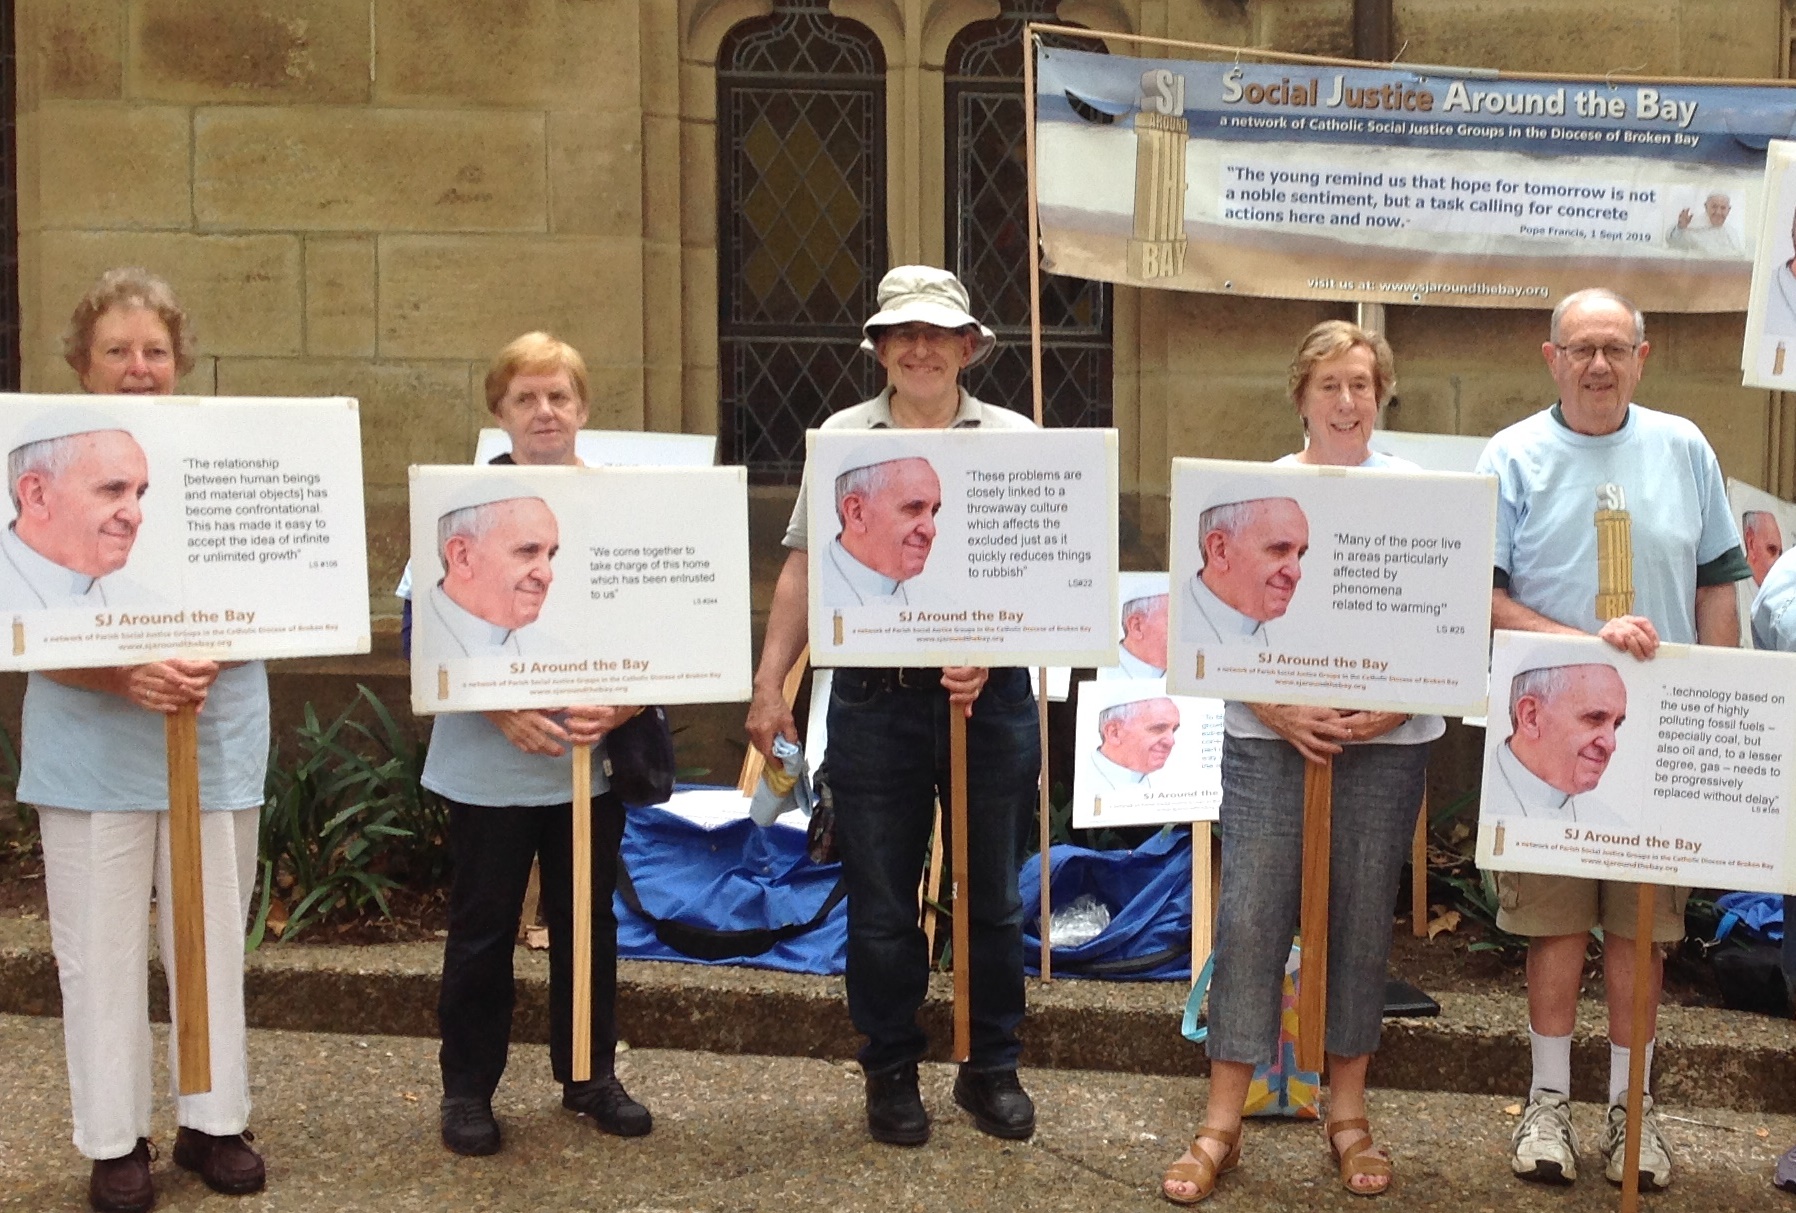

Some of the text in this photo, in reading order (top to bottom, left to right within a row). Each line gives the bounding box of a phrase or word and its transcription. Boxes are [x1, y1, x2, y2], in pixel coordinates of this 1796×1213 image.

[1155, 69, 1185, 116] SJ
[1222, 70, 1698, 127] Social Justice Around the Bay
[1149, 115, 1188, 132] AROUND
[1220, 115, 1700, 147] a network of Catholic Social Justice Groups in the Diocese of Broken Bay
[1228, 166, 1655, 203] "The young remind us that hope for tomorrow is not
[1226, 188, 1628, 221] a noble sentiment, but a task calling for concrete
[1225, 206, 1283, 222] actions
[1289, 209, 1325, 224] here
[1330, 212, 1360, 225] and
[1520, 225, 1545, 237] Pope
[1548, 227, 1586, 240] Francis,
[1592, 230, 1595, 238] 1
[1600, 230, 1622, 241] Sept
[1142, 241, 1188, 279] BAY
[1308, 277, 1549, 298] visit us at: www.sjaroundthebay.org
[213, 458, 279, 469] relationship
[240, 474, 320, 486] human beings
[1009, 470, 1081, 483] problems are
[185, 489, 327, 500] and material has
[967, 486, 1040, 500] closely linked
[186, 506, 232, 515] become
[967, 503, 1068, 515] throwaway culture
[187, 520, 311, 531] This has made easy
[968, 518, 1060, 530] which affects the
[188, 534, 329, 548] accept the idea infinite
[968, 534, 1041, 548] excluded just
[1390, 536, 1461, 549] the poor live
[203, 551, 255, 562] unlimited
[613, 546, 683, 558] come together
[968, 550, 1091, 564] quickly reduces things
[590, 560, 710, 572] take charge this home
[1348, 552, 1448, 567] areas particularly
[591, 573, 715, 585] which has been entrusted
[1334, 566, 1379, 579] affected
[1333, 583, 1402, 596] phenomena
[1333, 599, 1372, 611] related
[95, 610, 255, 627] SJ Around the Bay
[899, 610, 1023, 623] SJ Around the Bay
[510, 659, 649, 674] SJ Around the Bay
[1259, 653, 1388, 672] SJ Around the Bay
[1735, 691, 1767, 702] based
[1661, 700, 1749, 718] the use highly
[1660, 715, 1764, 732] polluting fossil fuels
[1658, 731, 1761, 746] especially coal, but
[1657, 743, 1782, 762] also oil and, lesser
[1656, 758, 1766, 776] degree, gas needs
[1672, 773, 1744, 791] progressively
[1654, 786, 1742, 802] replaced without
[1565, 829, 1702, 853] SJ Around the Bay
